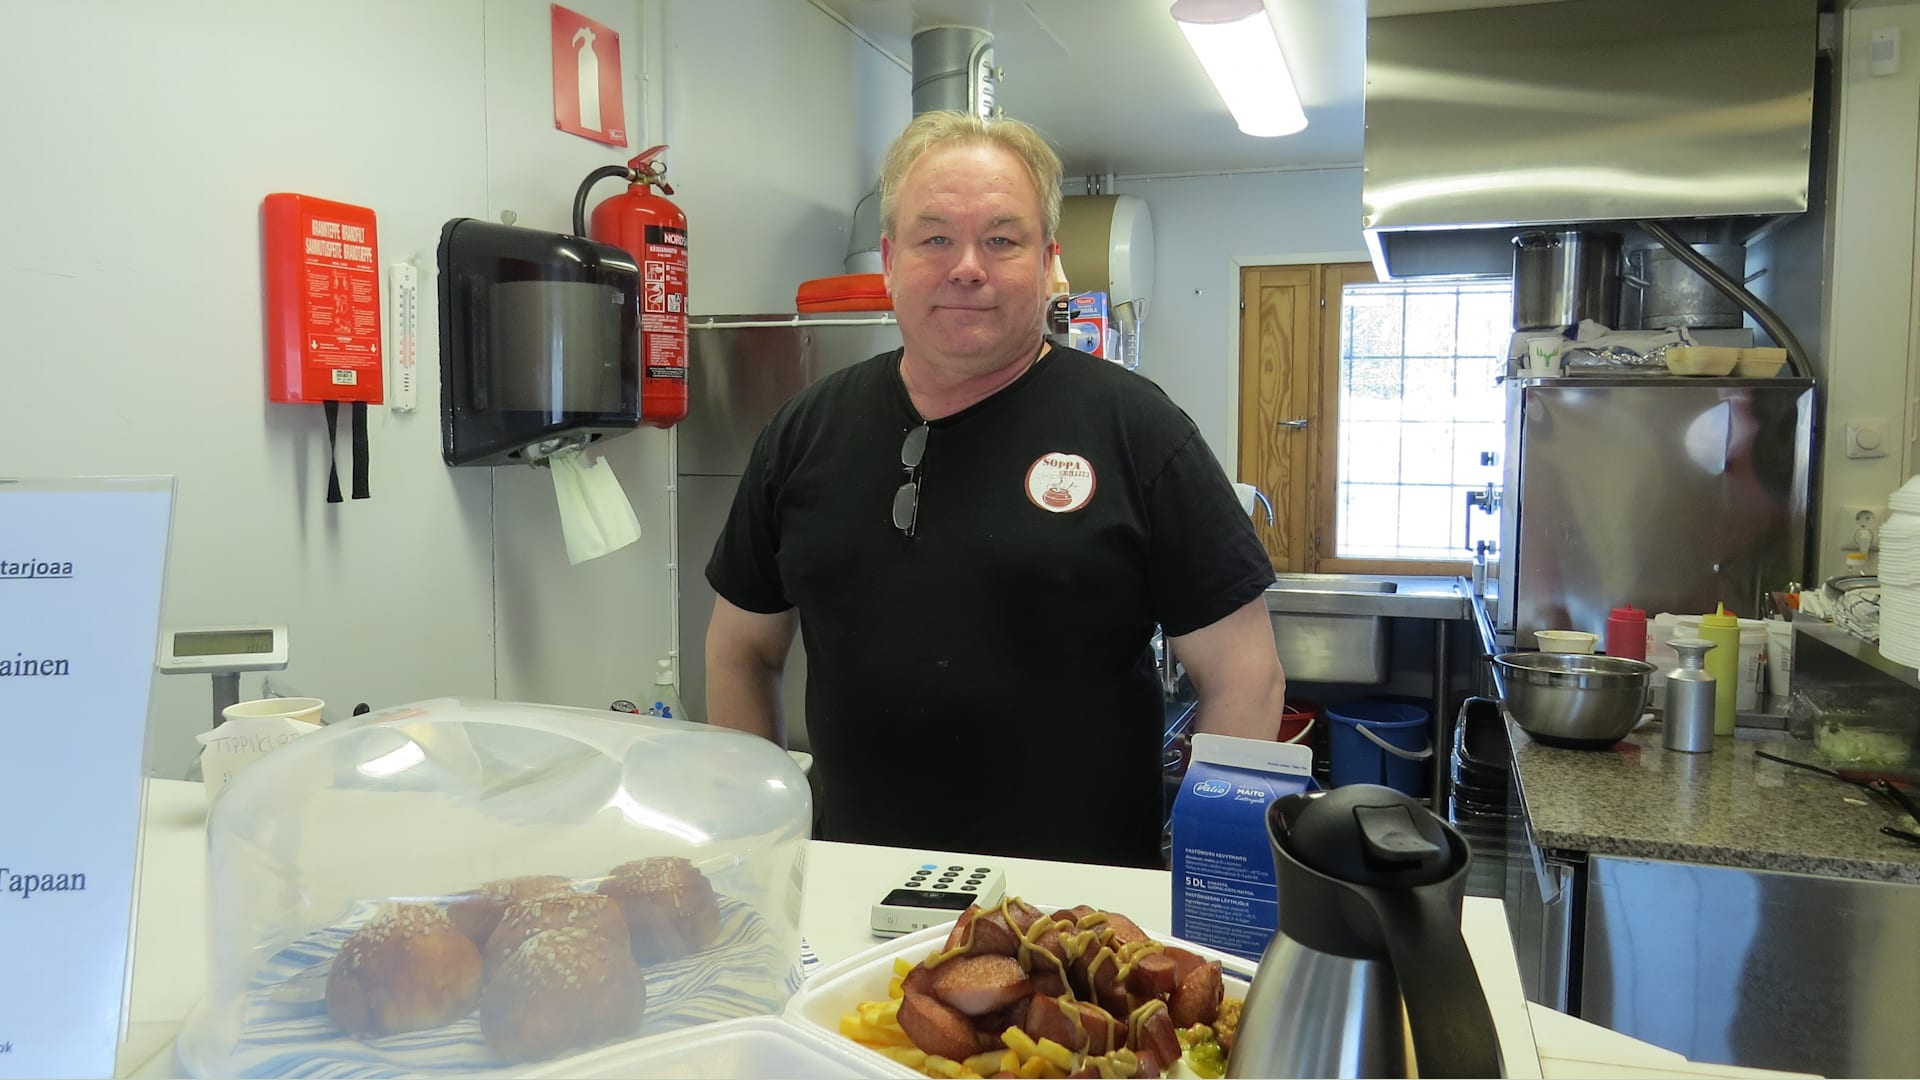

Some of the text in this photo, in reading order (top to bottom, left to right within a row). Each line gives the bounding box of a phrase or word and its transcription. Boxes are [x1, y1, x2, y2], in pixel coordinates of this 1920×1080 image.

[1042, 459, 1080, 470] SOPPA
[0, 558, 73, 578] tarjoaa
[0, 652, 70, 676] ainen
[1196, 784, 1225, 794] Valio
[1237, 788, 1265, 797] MAITO
[1185, 876, 1192, 886] 5
[1193, 878, 1206, 888] DL
